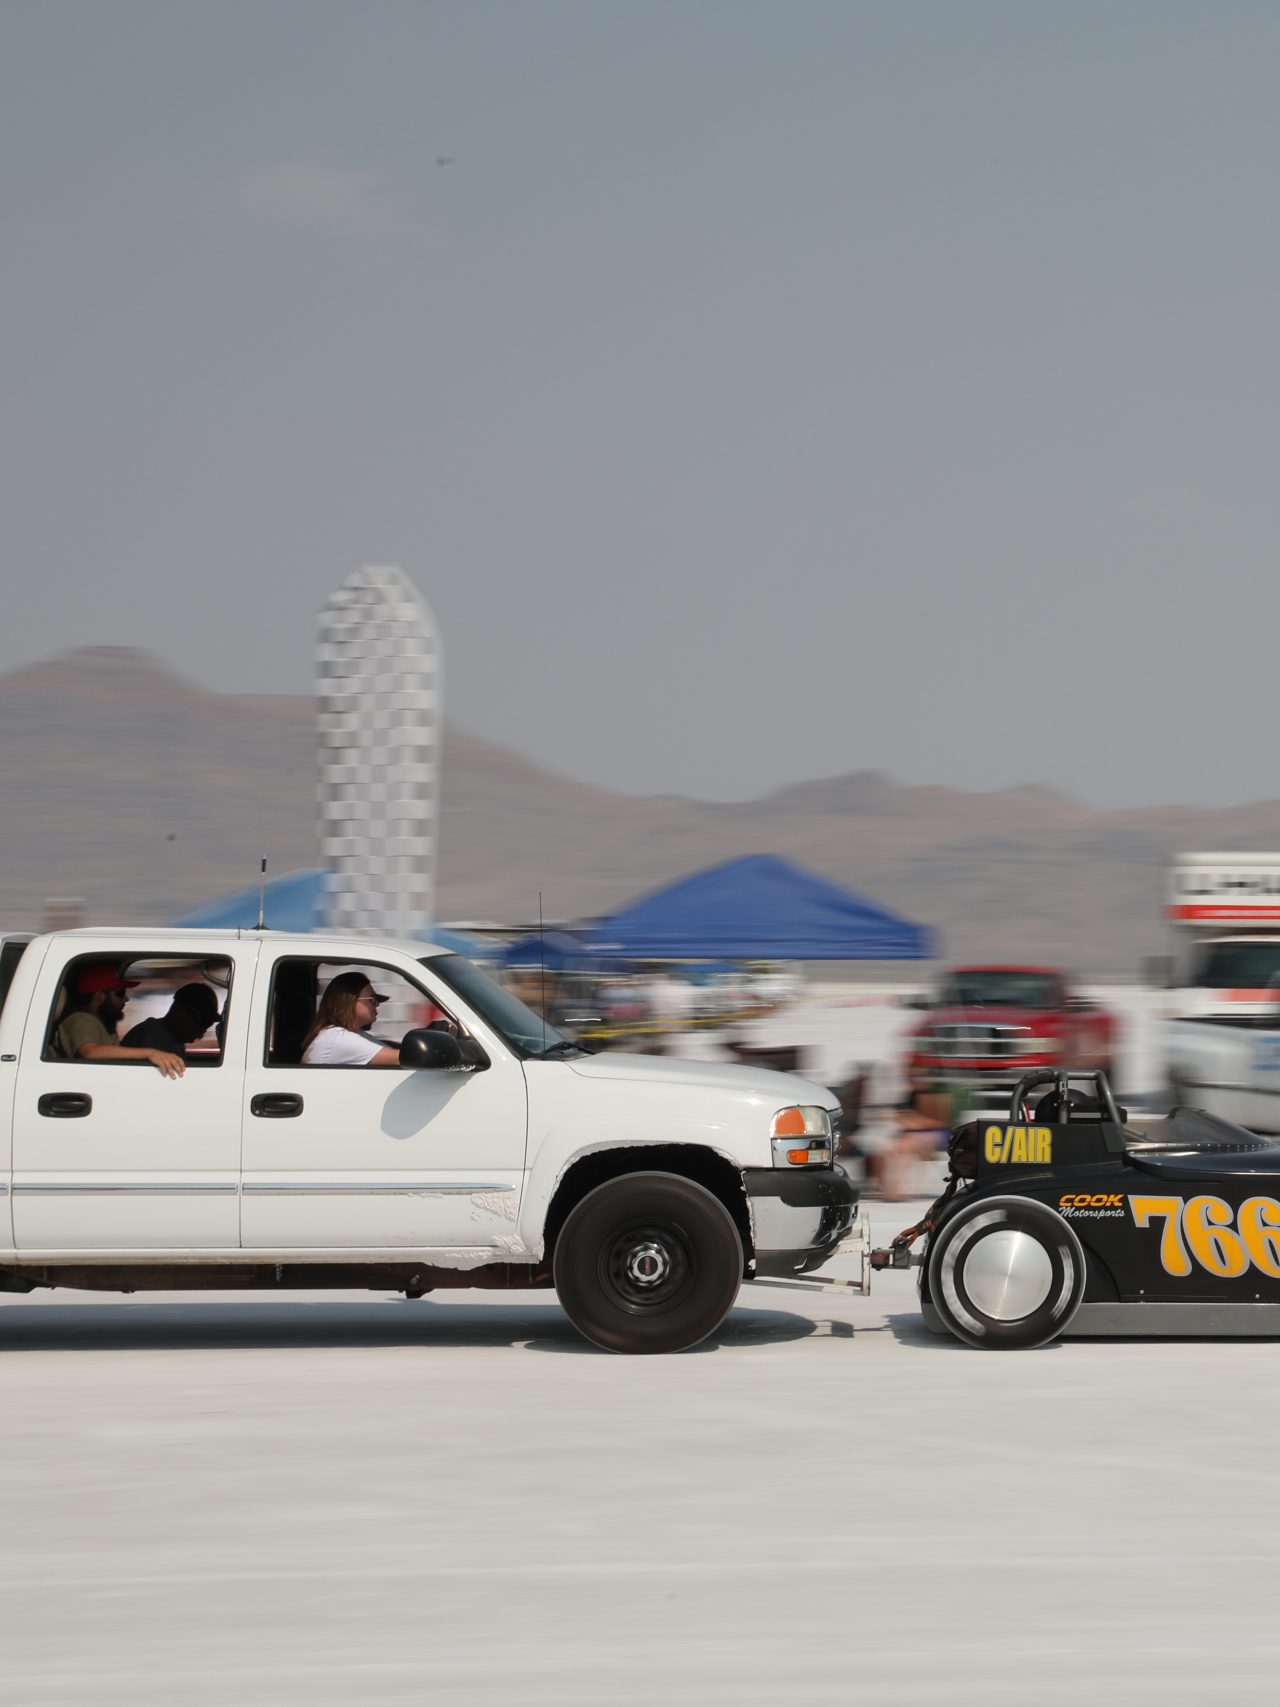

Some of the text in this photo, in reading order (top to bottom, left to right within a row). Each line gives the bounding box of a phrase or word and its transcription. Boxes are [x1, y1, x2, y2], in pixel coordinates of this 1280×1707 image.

[985, 1125, 1052, 1164] C/AIR
[1059, 1194, 1125, 1207] COOK
[1058, 1206, 1126, 1220] Motorsports
